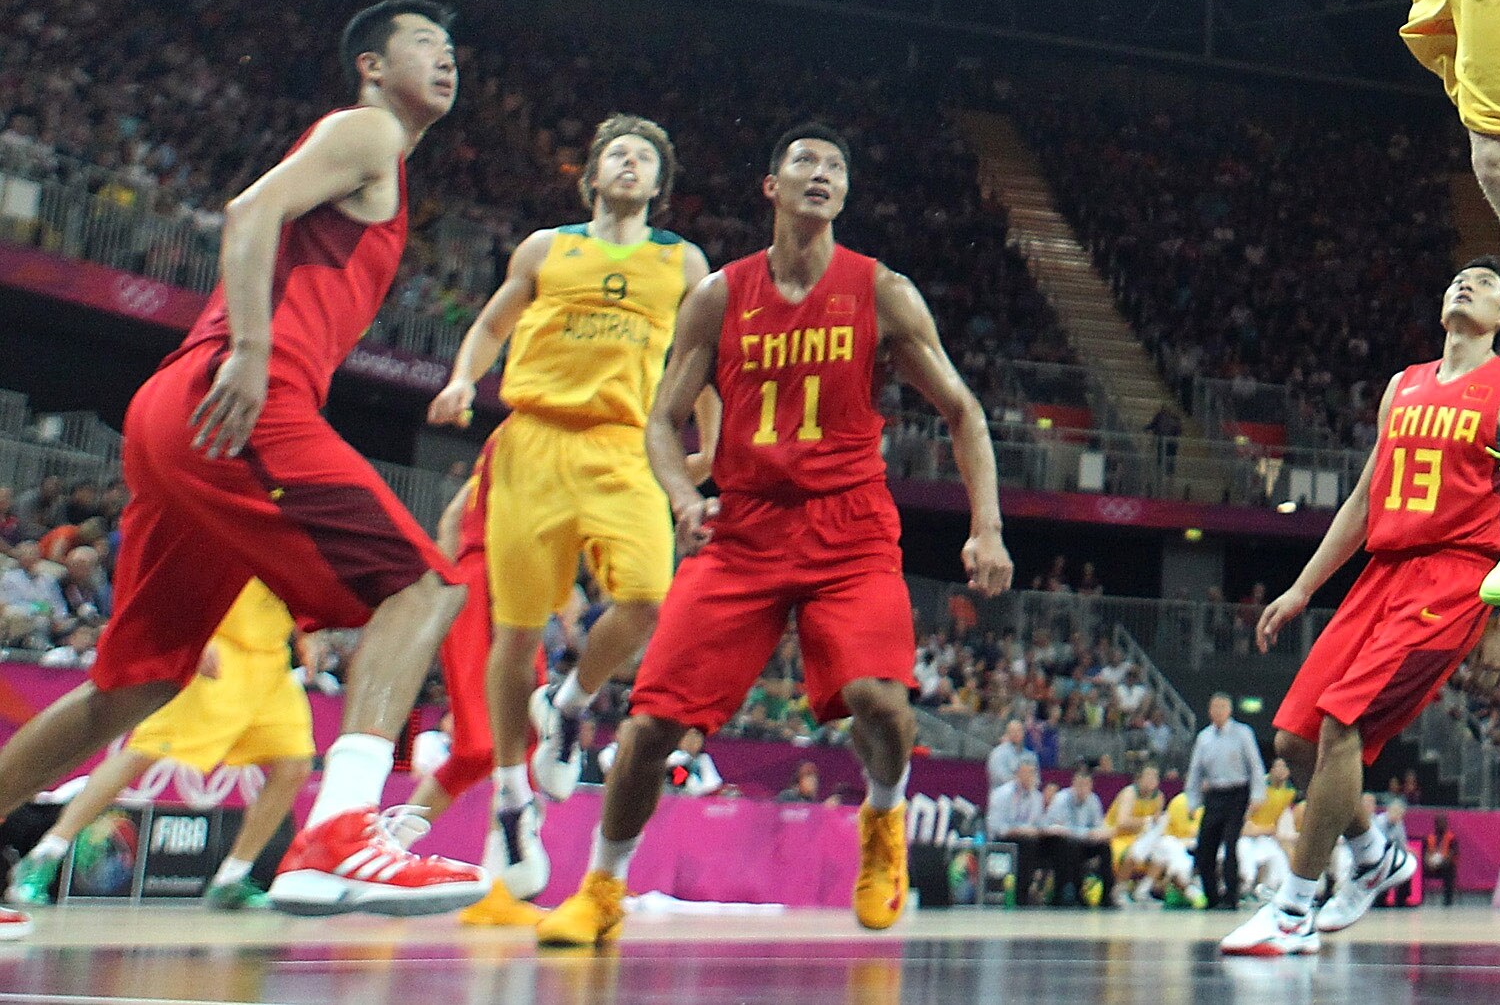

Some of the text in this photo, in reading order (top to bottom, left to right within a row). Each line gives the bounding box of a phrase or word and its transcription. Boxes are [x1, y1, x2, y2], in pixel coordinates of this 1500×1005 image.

[740, 326, 854, 371] CHINA
[752, 375, 823, 444] 11
[1387, 405, 1482, 443] CHINA
[1384, 447, 1443, 514] 13
[150, 816, 209, 853] FIBA
